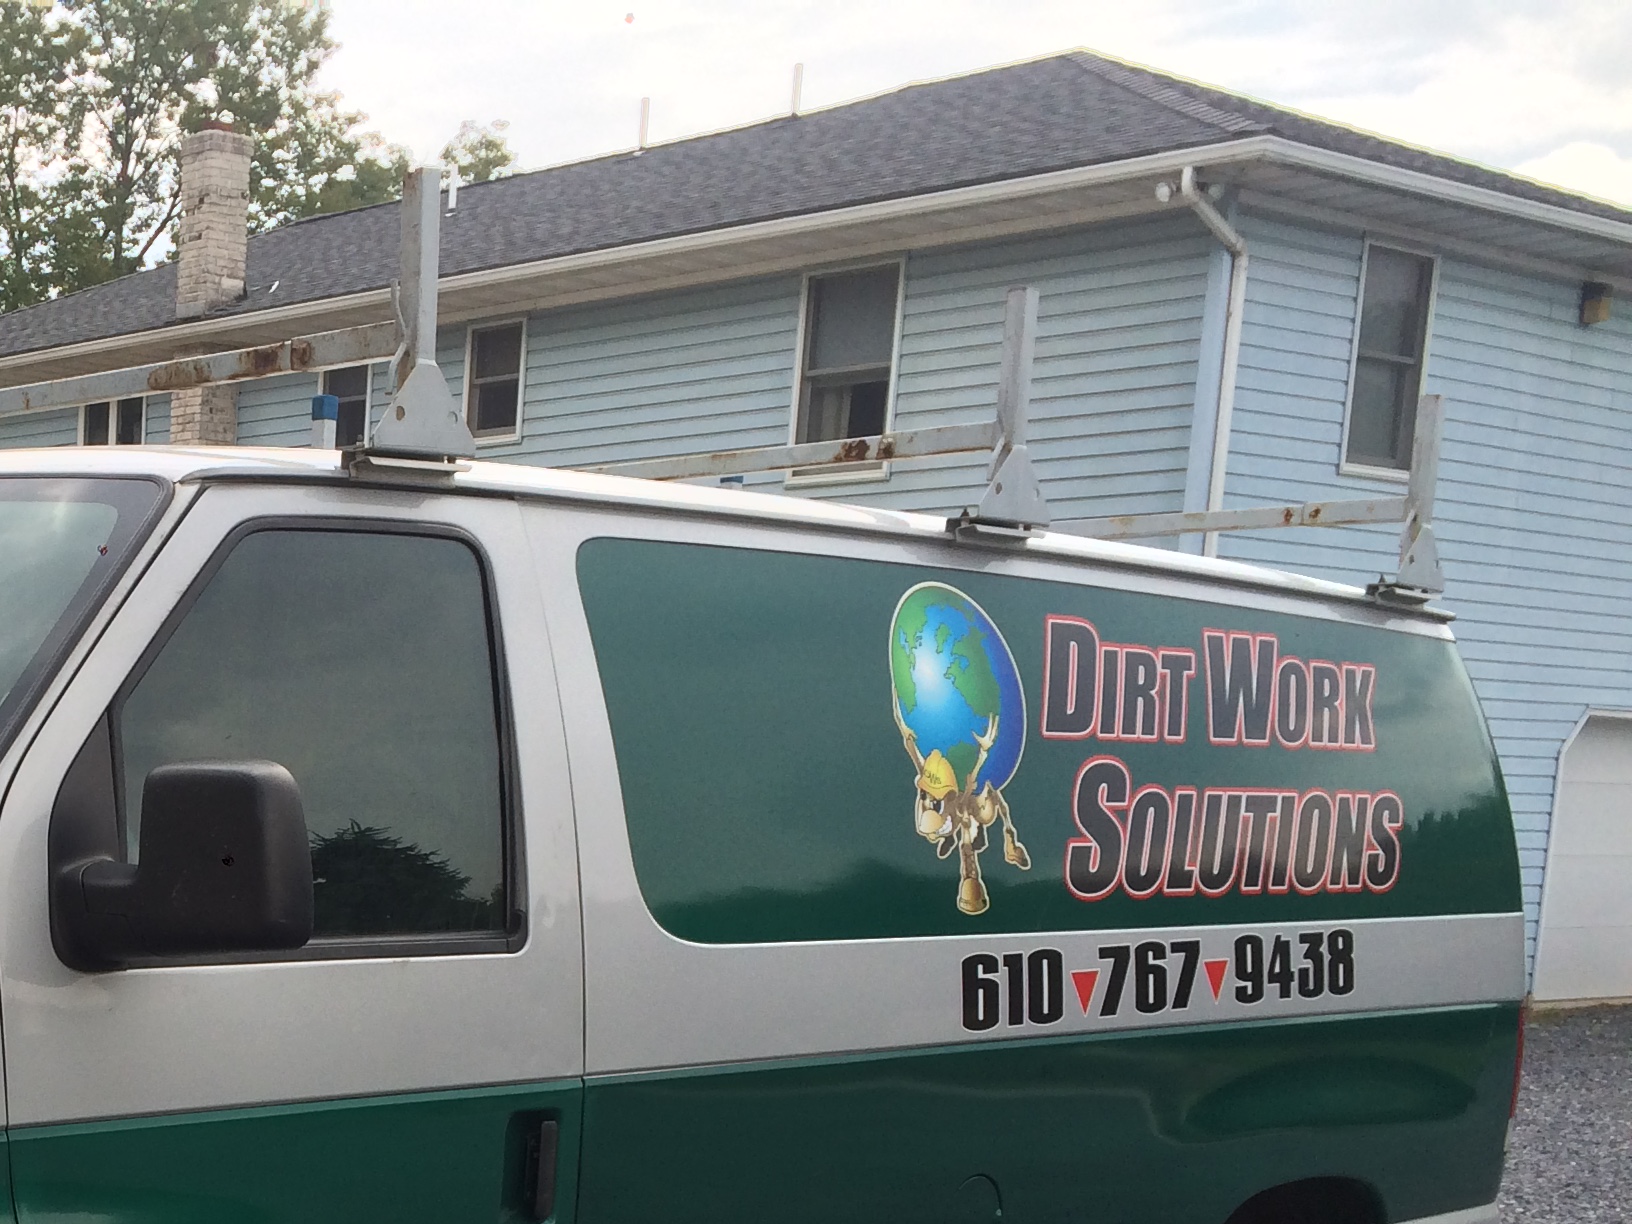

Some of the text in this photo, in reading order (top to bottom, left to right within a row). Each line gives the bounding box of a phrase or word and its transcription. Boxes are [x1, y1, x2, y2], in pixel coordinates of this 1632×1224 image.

[1041, 614, 1377, 751] DIRT WORK
[1065, 755, 1404, 900] SOLUTIONS
[961, 928, 1355, 1032] 610 767 9438
